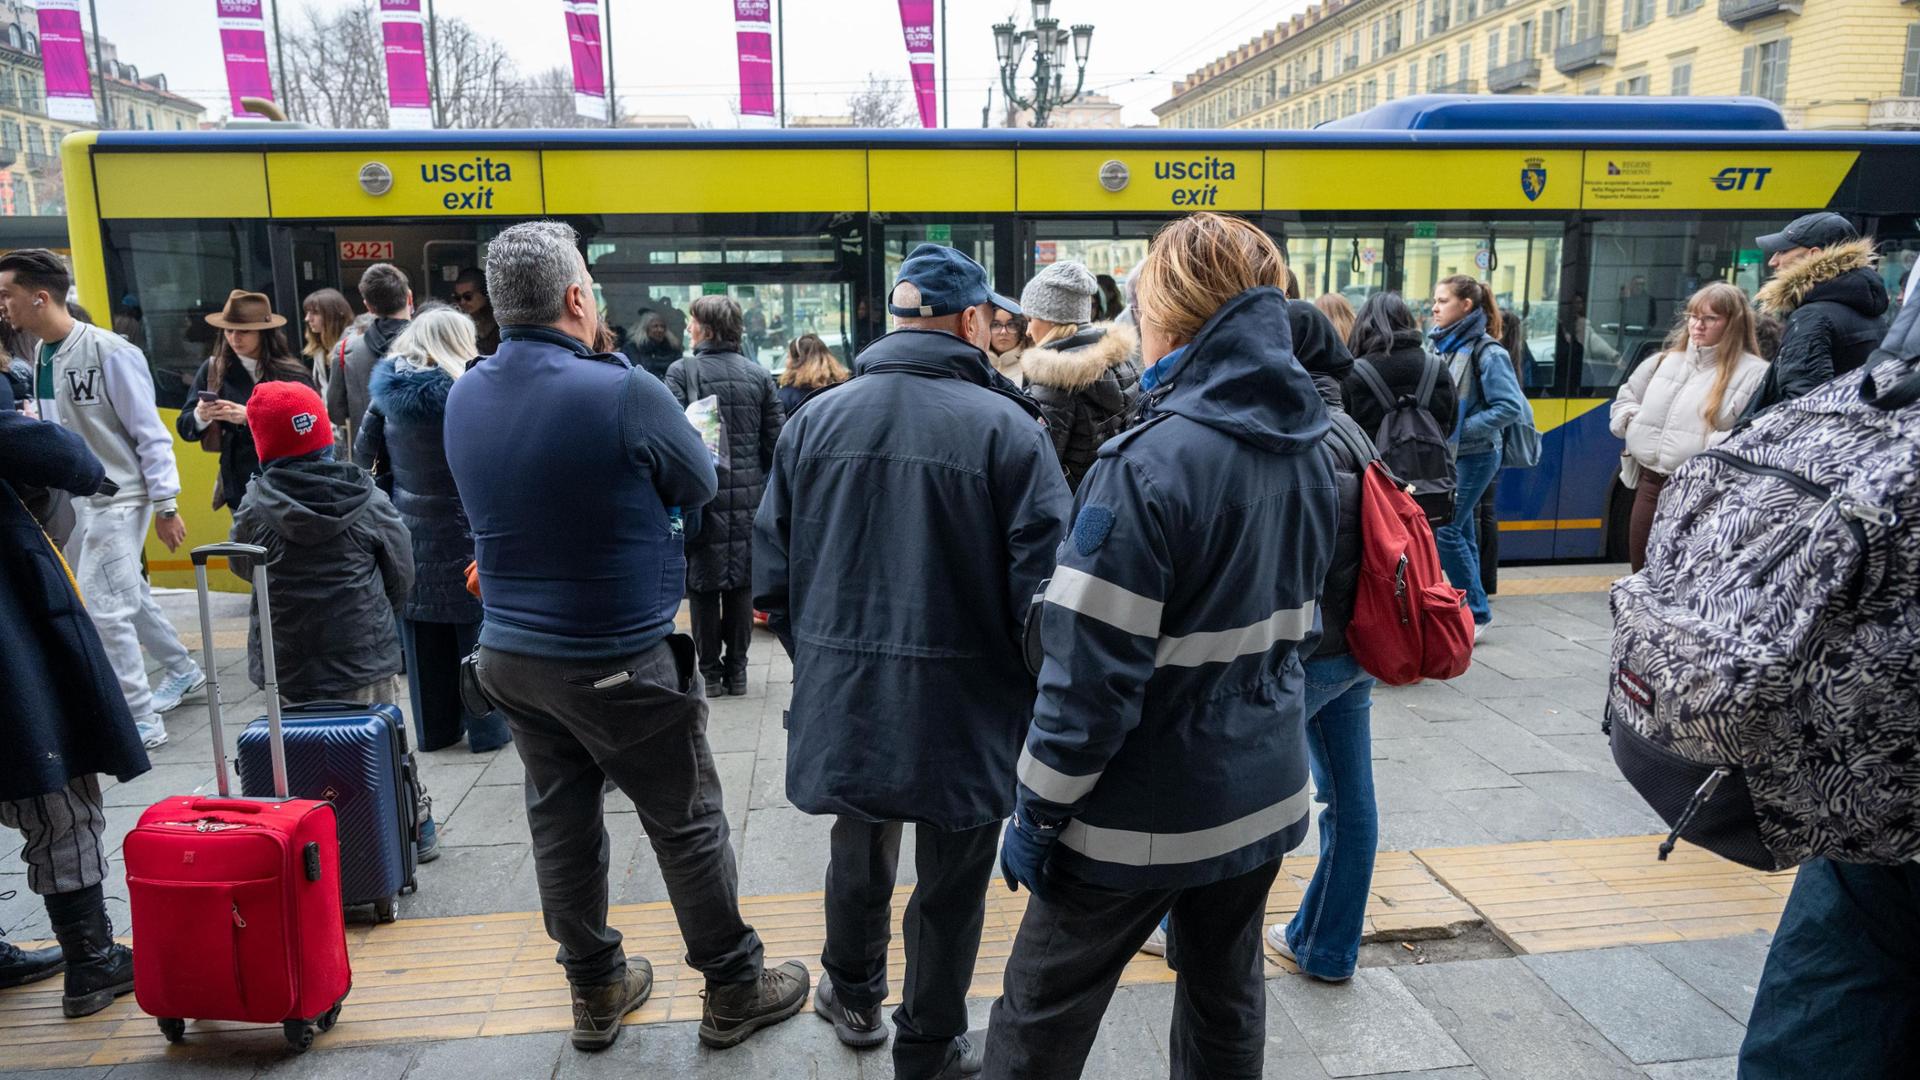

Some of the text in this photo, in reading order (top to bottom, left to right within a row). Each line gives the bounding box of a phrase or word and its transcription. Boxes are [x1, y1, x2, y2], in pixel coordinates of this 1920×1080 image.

[421, 157, 511, 183] uscita
[1155, 156, 1235, 180] uscita
[1709, 167, 1772, 191] GTT
[443, 186, 494, 209] exit
[1171, 184, 1218, 205] exit
[343, 242, 393, 259] 3421
[67, 369, 97, 401] W
